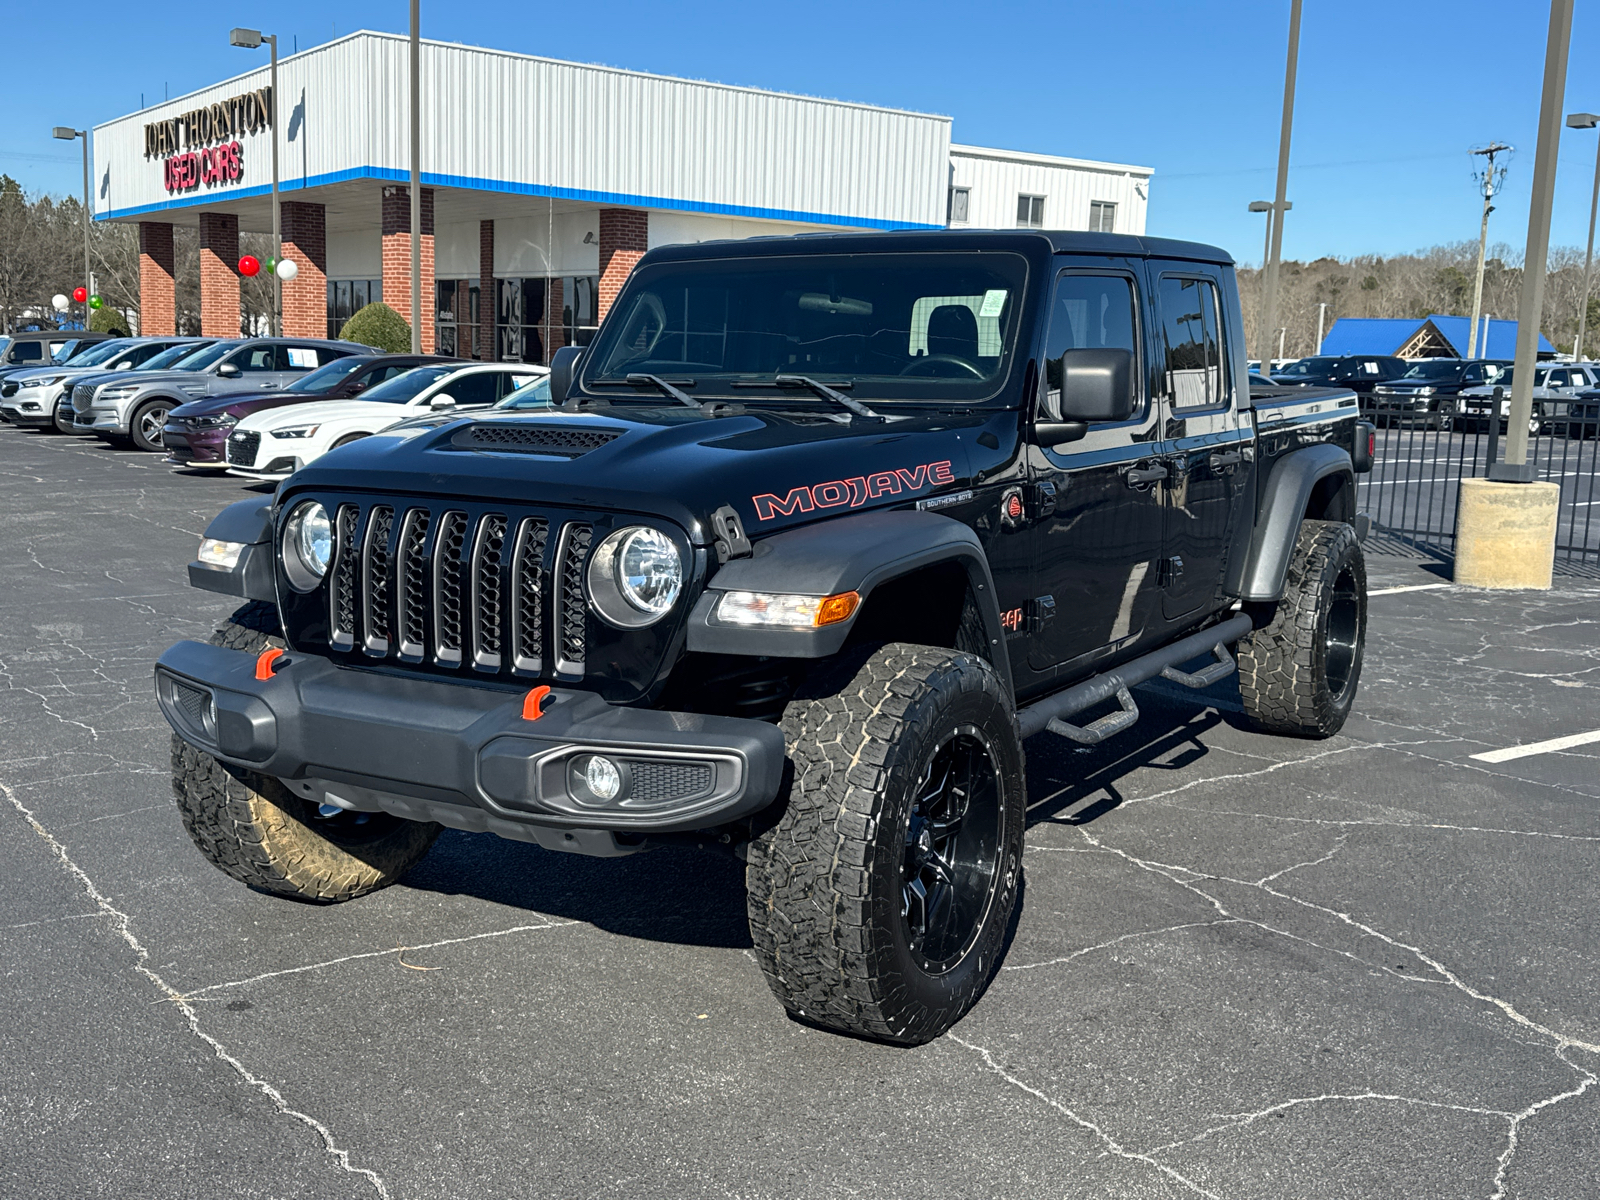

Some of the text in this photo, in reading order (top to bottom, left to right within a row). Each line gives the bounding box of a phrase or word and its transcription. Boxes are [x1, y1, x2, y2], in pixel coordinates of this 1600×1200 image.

[143, 86, 272, 158] JOHN THORNTON
[164, 140, 241, 191] USED CARS
[752, 460, 955, 521] MOJAVE
[999, 607, 1023, 631] eep
